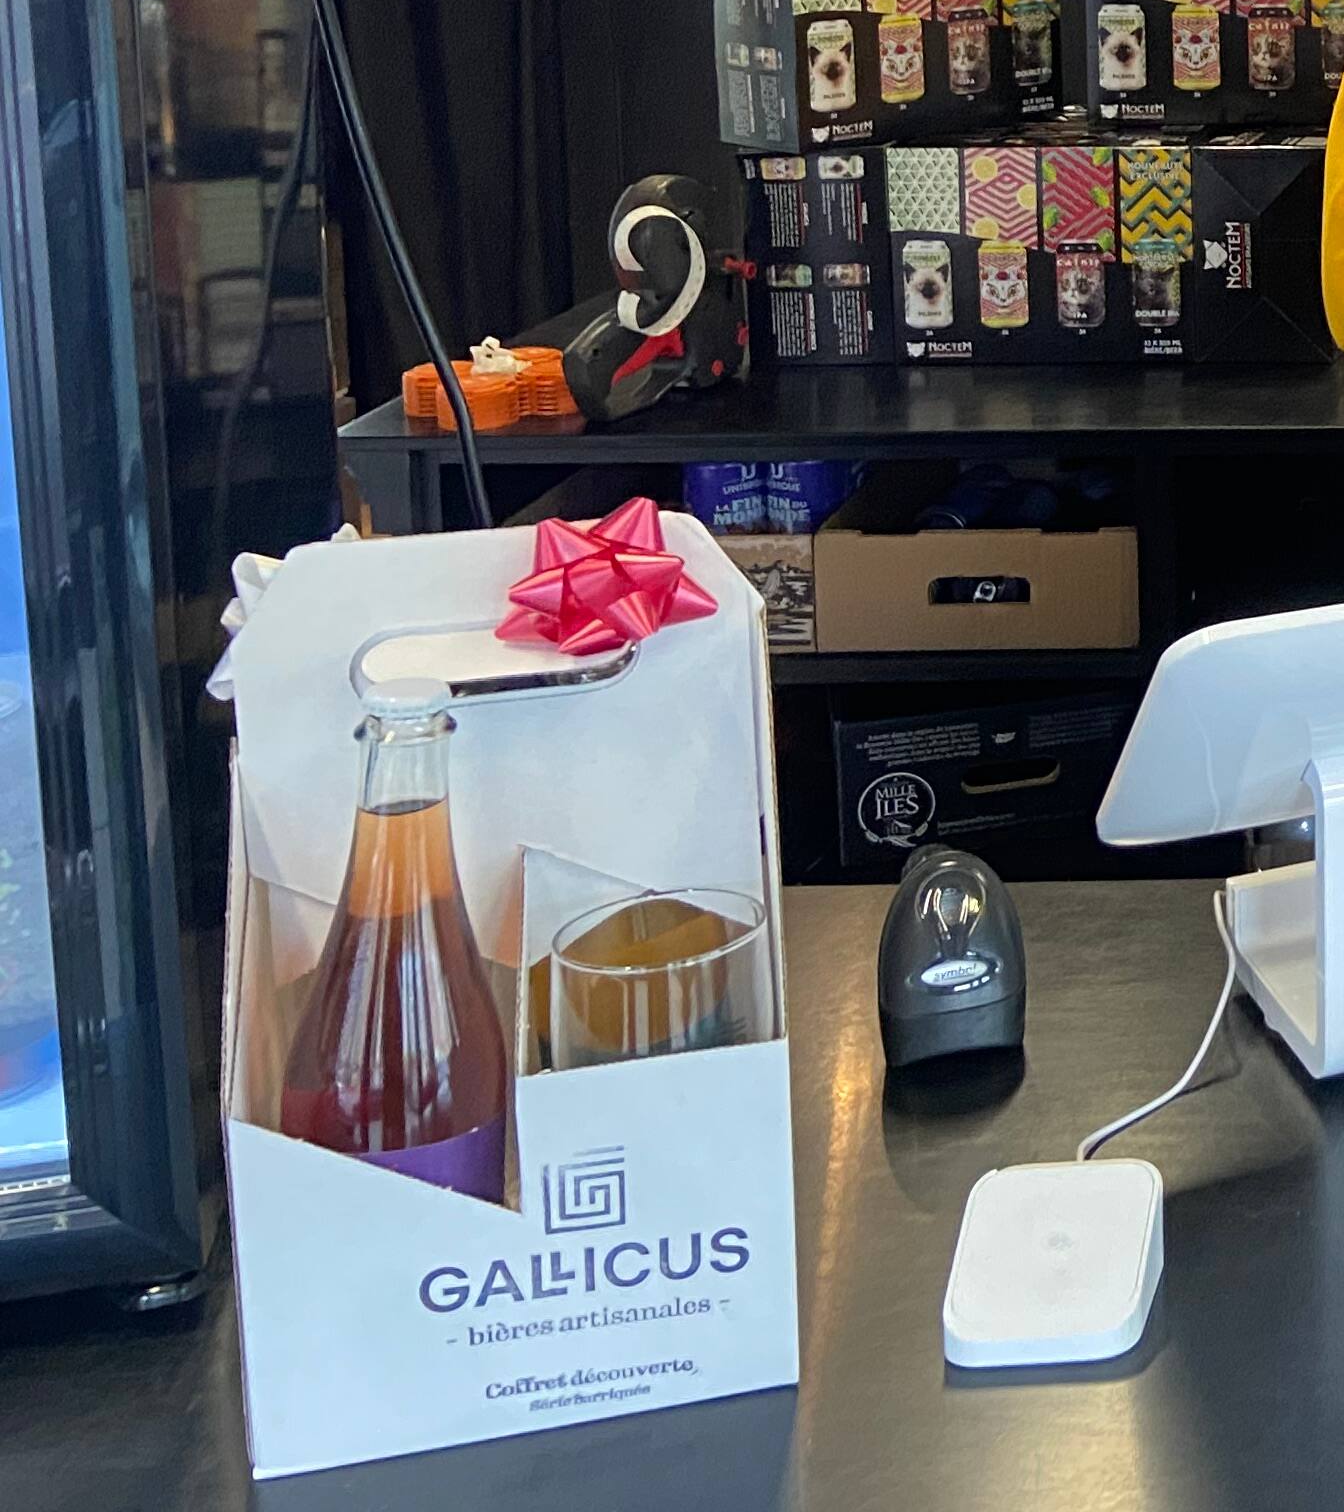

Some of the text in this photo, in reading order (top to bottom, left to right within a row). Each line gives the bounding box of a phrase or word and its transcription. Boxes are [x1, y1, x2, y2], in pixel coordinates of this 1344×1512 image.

[1224, 221, 1241, 289] NOCTEM
[732, 494, 762, 511] FIN
[874, 783, 916, 800] MILLE
[418, 1226, 752, 1314] GALLICUS
[468, 1295, 712, 1347] bières artisanales
[484, 1368, 567, 1401] Coffret
